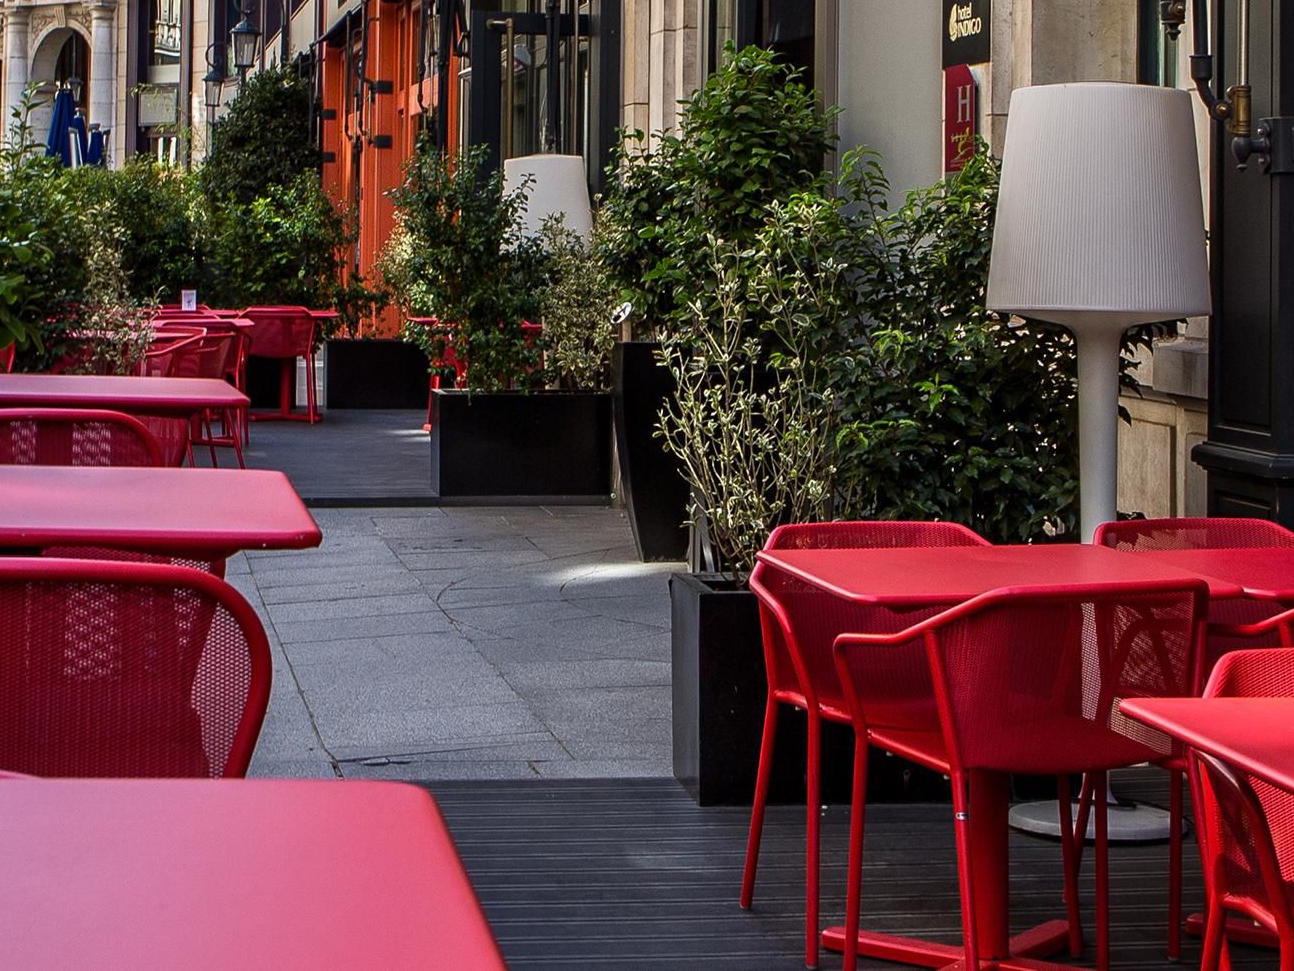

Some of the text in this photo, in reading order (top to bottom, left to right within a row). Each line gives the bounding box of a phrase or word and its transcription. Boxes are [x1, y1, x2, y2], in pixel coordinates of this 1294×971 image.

[957, 2, 972, 19] hotel
[956, 17, 982, 38] INDIGO
[956, 84, 972, 123] H
